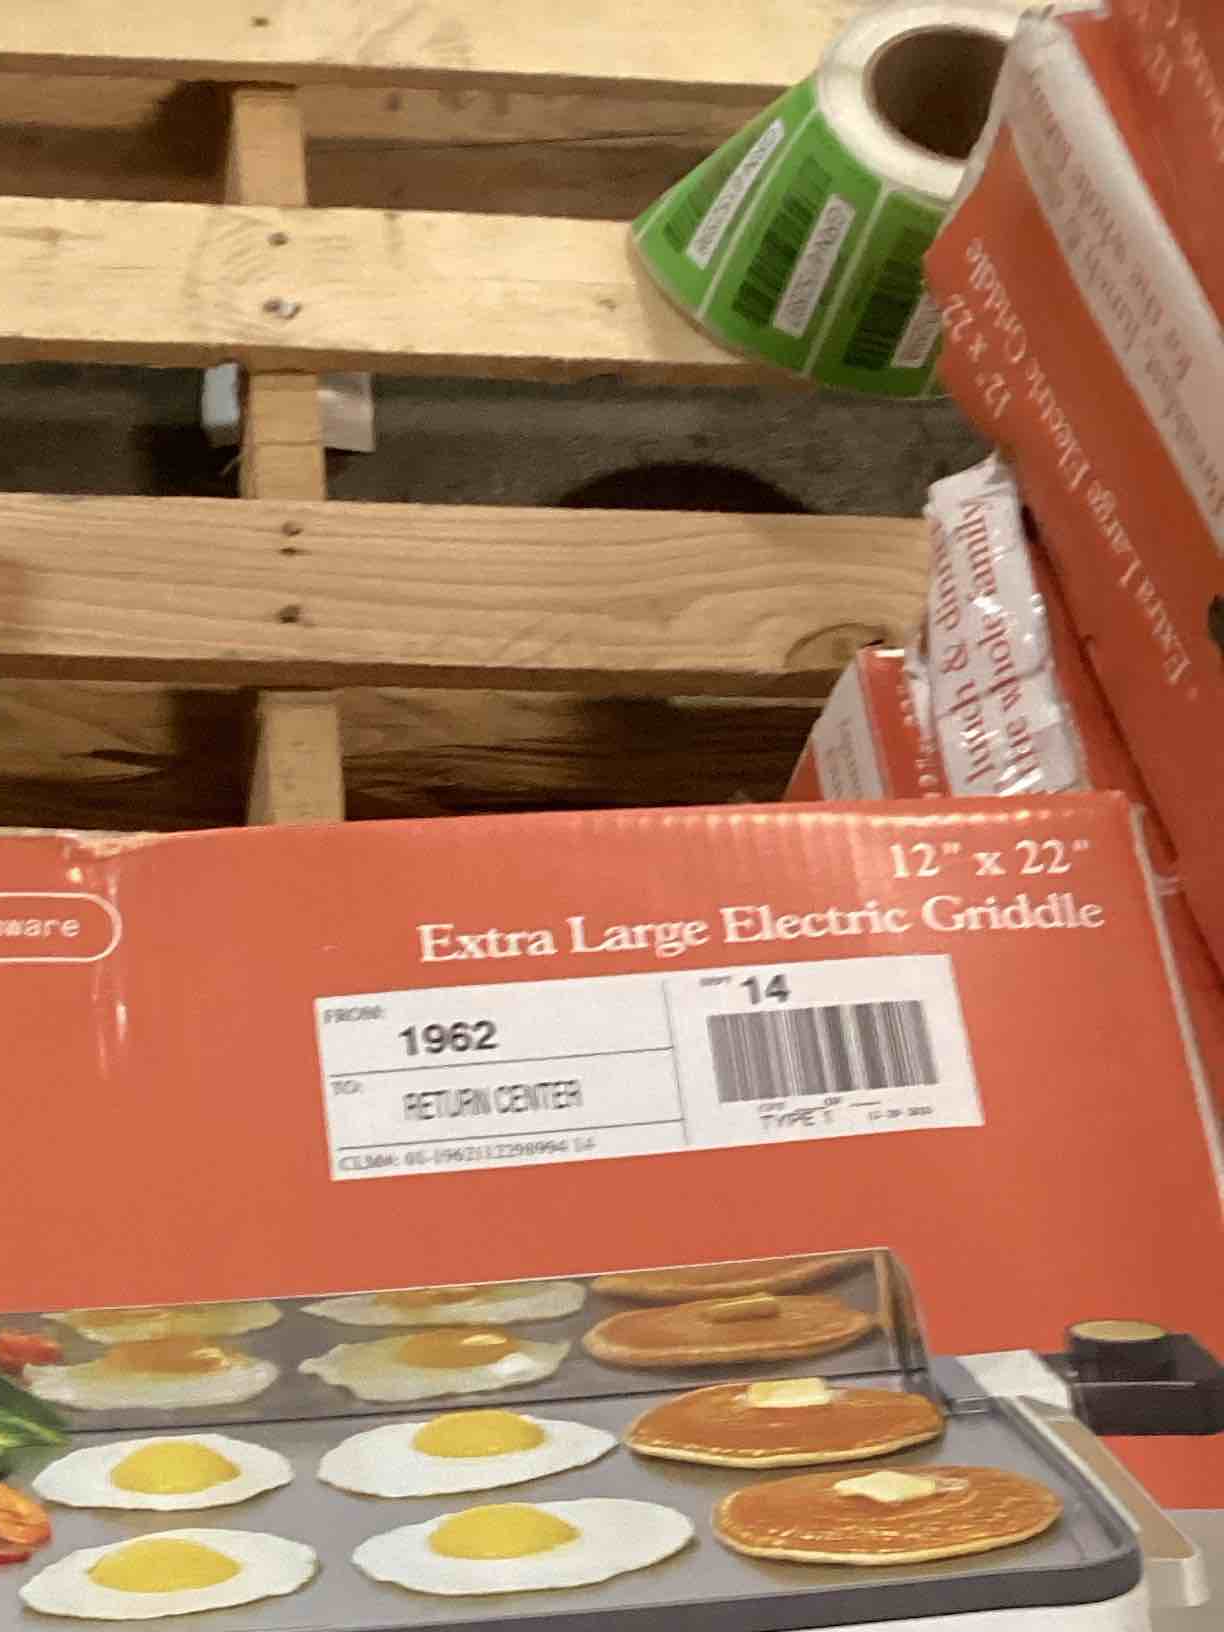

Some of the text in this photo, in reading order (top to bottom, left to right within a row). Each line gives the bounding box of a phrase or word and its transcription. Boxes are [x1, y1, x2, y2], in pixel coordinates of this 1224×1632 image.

[972, 850, 1007, 876] x
[416, 893, 1105, 963] Extra Large Electric Griddle
[742, 973, 791, 1005] 14
[398, 1019, 500, 1056] 1962
[403, 1090, 492, 1120] RETURN
[494, 1079, 581, 1113] CENTER
